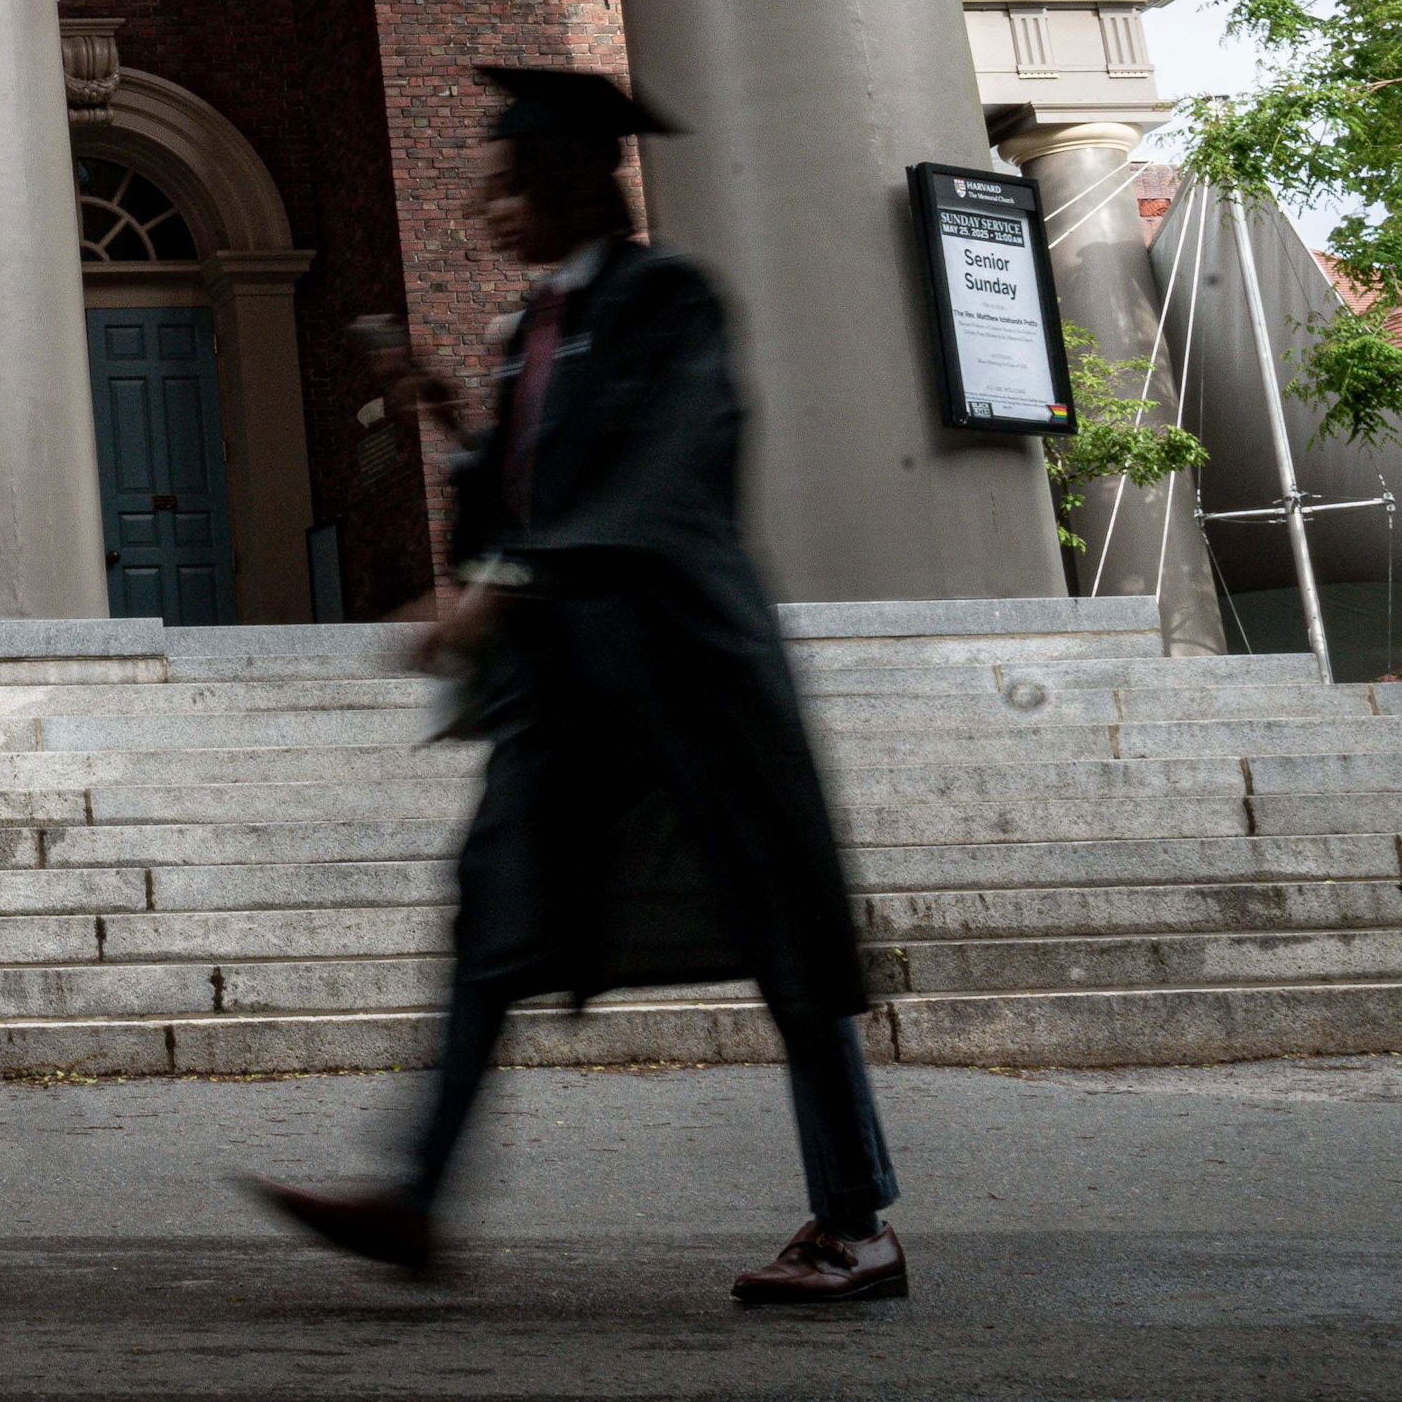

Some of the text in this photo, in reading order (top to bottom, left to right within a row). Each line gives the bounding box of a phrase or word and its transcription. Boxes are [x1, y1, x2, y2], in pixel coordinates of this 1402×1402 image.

[966, 181, 1001, 194] HARVARD
[941, 212, 1022, 235] SUNDAY SERVICE
[942, 223, 958, 234] MAY
[971, 228, 989, 239] 2025
[964, 248, 1010, 271] Senior
[964, 272, 1017, 300] Sunday
